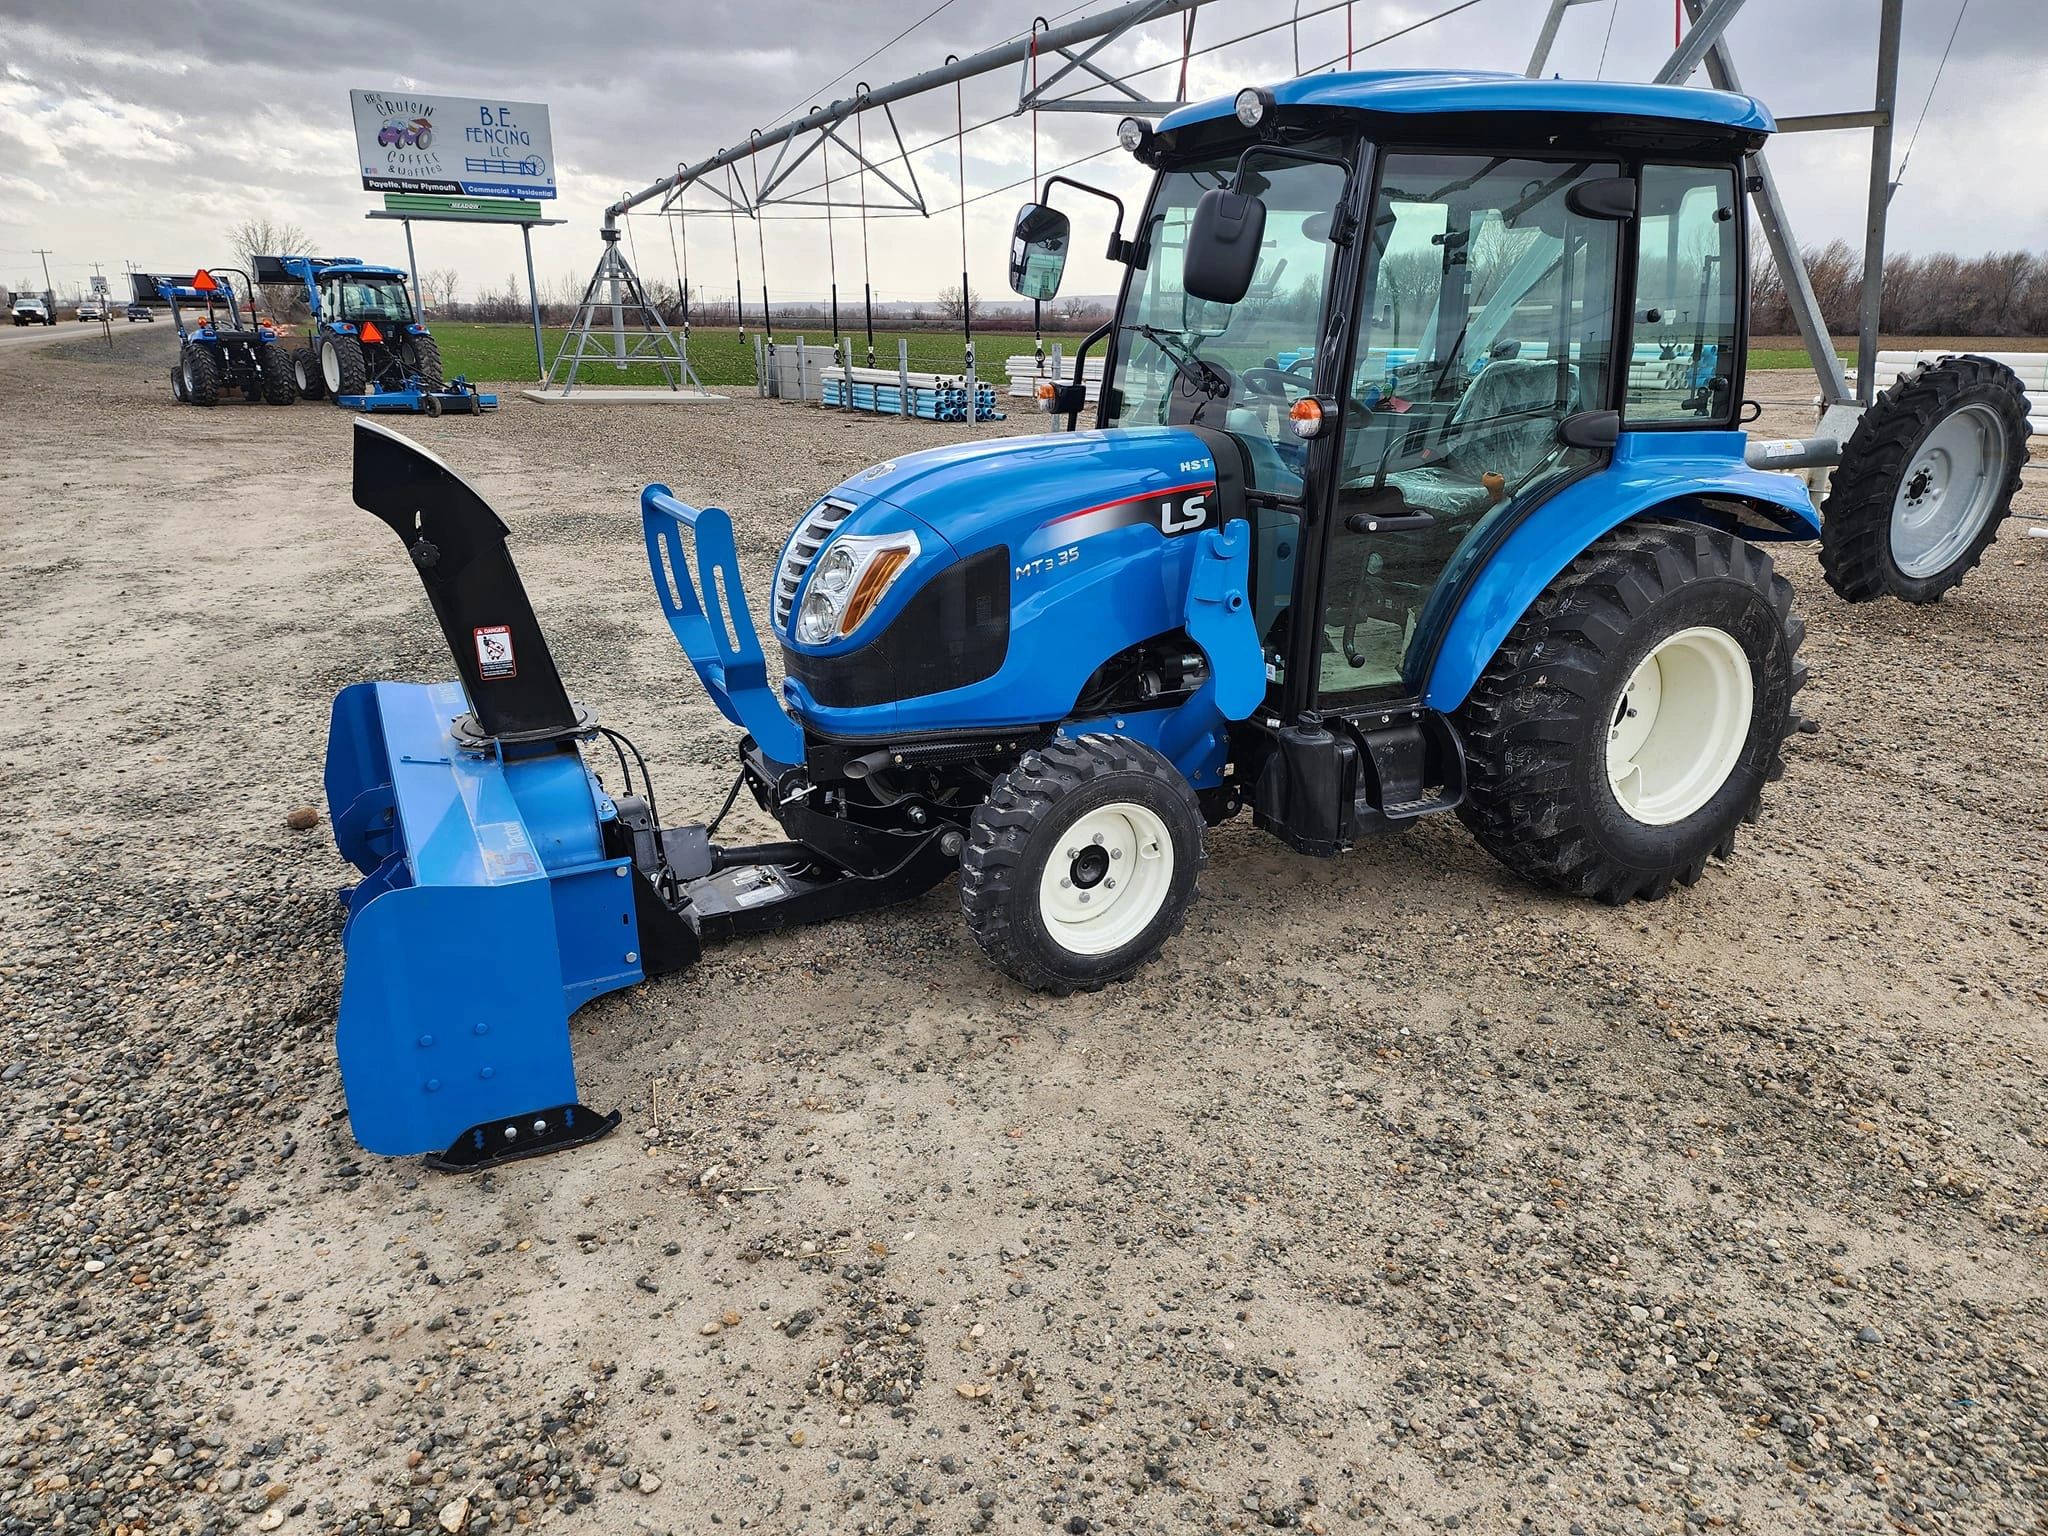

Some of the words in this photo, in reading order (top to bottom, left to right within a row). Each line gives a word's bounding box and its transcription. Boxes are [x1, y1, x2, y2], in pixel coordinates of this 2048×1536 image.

[480, 106, 517, 128] B.E.
[465, 127, 530, 146] FENCING
[490, 146, 511, 158] LLC
[401, 182, 419, 190] New
[420, 182, 456, 192] Plymouth
[468, 185, 510, 195] Commercial
[517, 188, 554, 197] Residential
[94, 284, 107, 294] 45
[1179, 457, 1210, 473] HST
[1161, 495, 1207, 534] LS
[1057, 546, 1080, 566] 35
